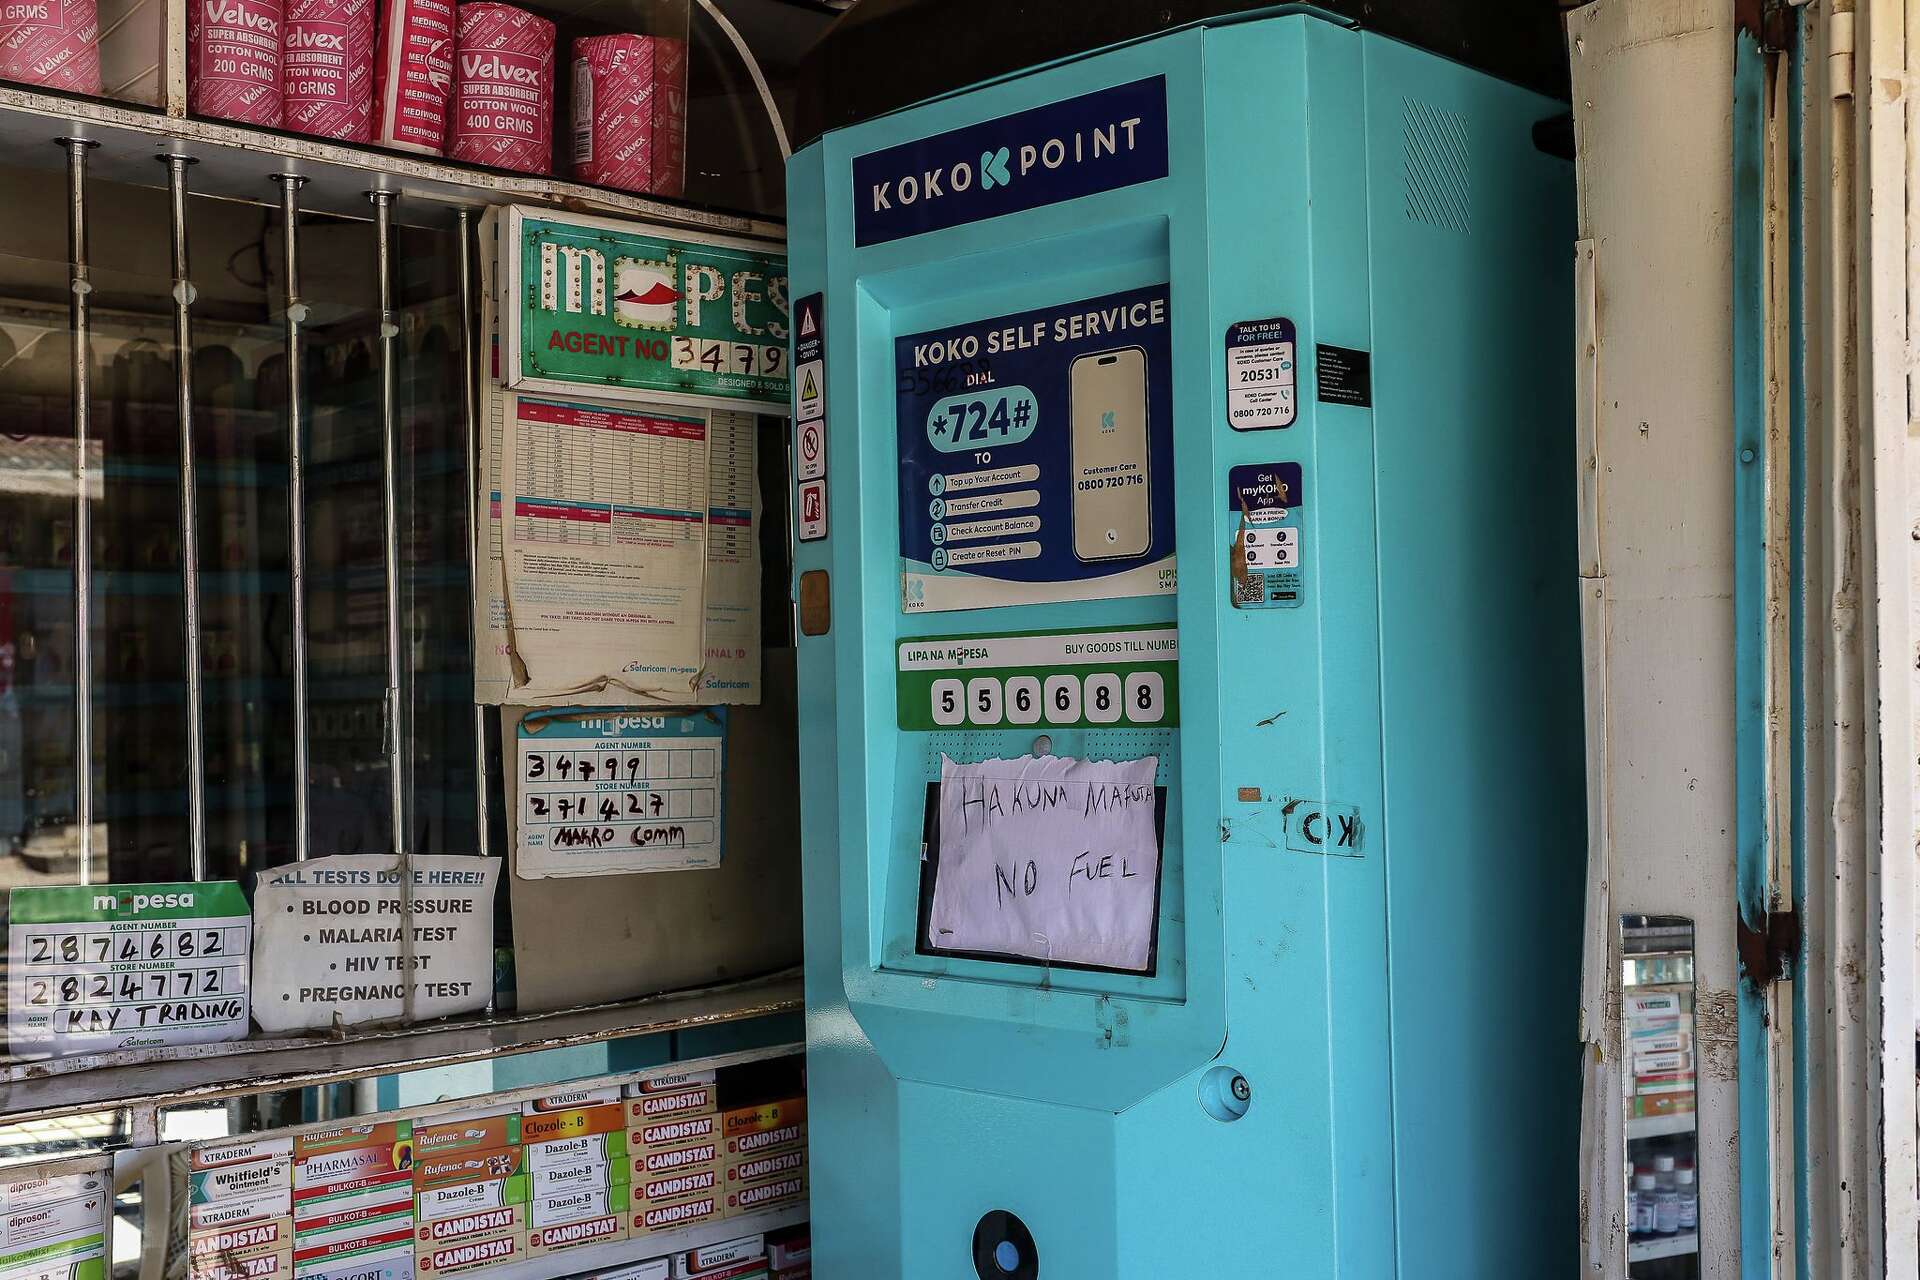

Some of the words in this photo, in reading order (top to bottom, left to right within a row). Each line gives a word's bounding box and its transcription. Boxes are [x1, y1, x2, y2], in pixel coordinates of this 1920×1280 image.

[6, 5, 48, 20] GRMS
[205, 0, 278, 36] Velvex
[411, 15, 449, 33] MEDIWOOL
[207, 29, 235, 41] SUPER
[236, 31, 279, 50] ABSORBENT
[285, 26, 344, 51] elvex
[33, 47, 73, 76] Velvex
[208, 44, 252, 58] COTTON
[255, 49, 278, 66] WOOL
[295, 54, 343, 66] ABSORBENT
[214, 58, 236, 73] 200
[240, 62, 274, 82] GRMS
[312, 69, 343, 80] WOOL
[461, 54, 540, 86] Velvex
[299, 82, 336, 96] GRMS
[405, 88, 443, 105] MEDIWOOL
[463, 84, 490, 96] SUPER
[492, 85, 539, 103] ABSORBENT
[403, 106, 442, 123] MEDIWOOL
[463, 99, 508, 112] COTTON
[511, 100, 539, 117] WOOL
[401, 125, 440, 140] MEDIWOOL
[466, 115, 490, 130] 400
[494, 115, 534, 135] GRMS
[615, 136, 646, 163] Velvex
[873, 162, 972, 212] KOKO
[1020, 117, 1141, 176] POINT
[915, 335, 979, 368] KOKO
[987, 322, 1046, 354] SELF
[1054, 299, 1164, 342] SERVICE
[1257, 332, 1282, 340] FREE!
[548, 329, 629, 358] AGENT
[635, 338, 668, 362] NO
[966, 371, 995, 386] DIAL
[1241, 368, 1280, 382] 20531
[718, 377, 756, 389] DESIGNED
[764, 382, 784, 391] SOLD
[1234, 409, 1254, 418] 0800
[1274, 406, 1290, 414] 716
[975, 453, 991, 465] TO
[1083, 466, 1118, 476] Customer
[1119, 462, 1137, 472] Care
[950, 477, 963, 489] Top
[964, 477, 973, 487] up
[974, 474, 990, 485] Your
[991, 470, 1021, 482] Account
[1078, 478, 1104, 491] 0800
[1105, 477, 1125, 489] 720
[1126, 475, 1144, 486] 716
[1258, 474, 1272, 482] Get
[950, 500, 980, 513] Transfer
[981, 498, 1003, 509] Credit
[1257, 497, 1274, 505] App
[951, 526, 973, 536] Check
[974, 523, 1004, 533] Account
[1004, 519, 1034, 531] Balance
[952, 551, 976, 561] Create
[977, 551, 985, 559] or
[985, 549, 1006, 558] Reset
[1009, 547, 1021, 556] PIN
[705, 648, 732, 658] INAL
[908, 650, 928, 662] LIPA
[930, 650, 944, 661] NA
[1065, 643, 1085, 654] BUY
[1087, 642, 1122, 653] GOODS
[1124, 641, 1145, 652] TILL
[630, 664, 667, 673] Safaricom
[706, 680, 750, 689] Safaricom
[619, 782, 650, 790] NUMBER
[962, 776, 1068, 838] HAKUNA
[1084, 781, 1154, 821] MAFUTA
[313, 871, 371, 884] TESTS
[377, 870, 423, 884] DOE
[428, 871, 485, 884] HERE!!
[995, 860, 1038, 910] NO
[1069, 851, 1136, 901] FUEL
[303, 900, 370, 915] BLOOD
[110, 923, 138, 931] AGENT
[141, 922, 177, 930] NUMBER
[320, 928, 403, 944] MALARIA
[413, 927, 457, 941] TEST
[110, 963, 136, 971] STORE
[139, 962, 175, 970] NUMBER
[346, 957, 379, 972] HIV
[425, 982, 472, 997] TEST
[67, 1008, 121, 1032] KAY
[135, 1000, 242, 1027] TRADING
[127, 1038, 164, 1047] Safaricom
[653, 1075, 687, 1087] XTRADERM
[549, 1093, 588, 1105] XTRADERM
[644, 1091, 706, 1114] CANDISTAT
[525, 1120, 566, 1135] Clozole
[577, 1116, 584, 1127] B
[728, 1113, 762, 1128] Clozole
[772, 1108, 778, 1119] B
[420, 1132, 458, 1145] Rufenac
[645, 1120, 711, 1143] CANDISTAT
[739, 1126, 798, 1151] CANDISTAT
[545, 1139, 588, 1154] Dazole-B
[204, 1147, 252, 1163] XTRADERM
[648, 1147, 714, 1169] CANDISTAT
[424, 1163, 462, 1176] Rufenac
[549, 1165, 592, 1181] Dazole-B
[739, 1154, 801, 1178] CANDISTAT
[216, 1166, 280, 1185] Whitfield's
[230, 1177, 269, 1190] Ointment
[10, 1179, 48, 1193] diproson
[328, 1180, 367, 1193] BULKOT-B
[437, 1185, 484, 1201] Dazole-B
[647, 1173, 713, 1197] CANDISTAT
[740, 1180, 801, 1204] CANDISTAT
[548, 1193, 591, 1209] Dazole-B
[9, 1212, 48, 1227] diproson
[202, 1207, 250, 1224] XTRADERM
[328, 1210, 367, 1224] BULKOT-B
[646, 1200, 713, 1225] CANDISTAT
[434, 1210, 512, 1238] CANDISTAT
[543, 1218, 616, 1244] CANDISTAT
[328, 1240, 367, 1254] BULKOT-B
[435, 1239, 513, 1267] CANDISTAT
[701, 1252, 735, 1267] XTRADERM
